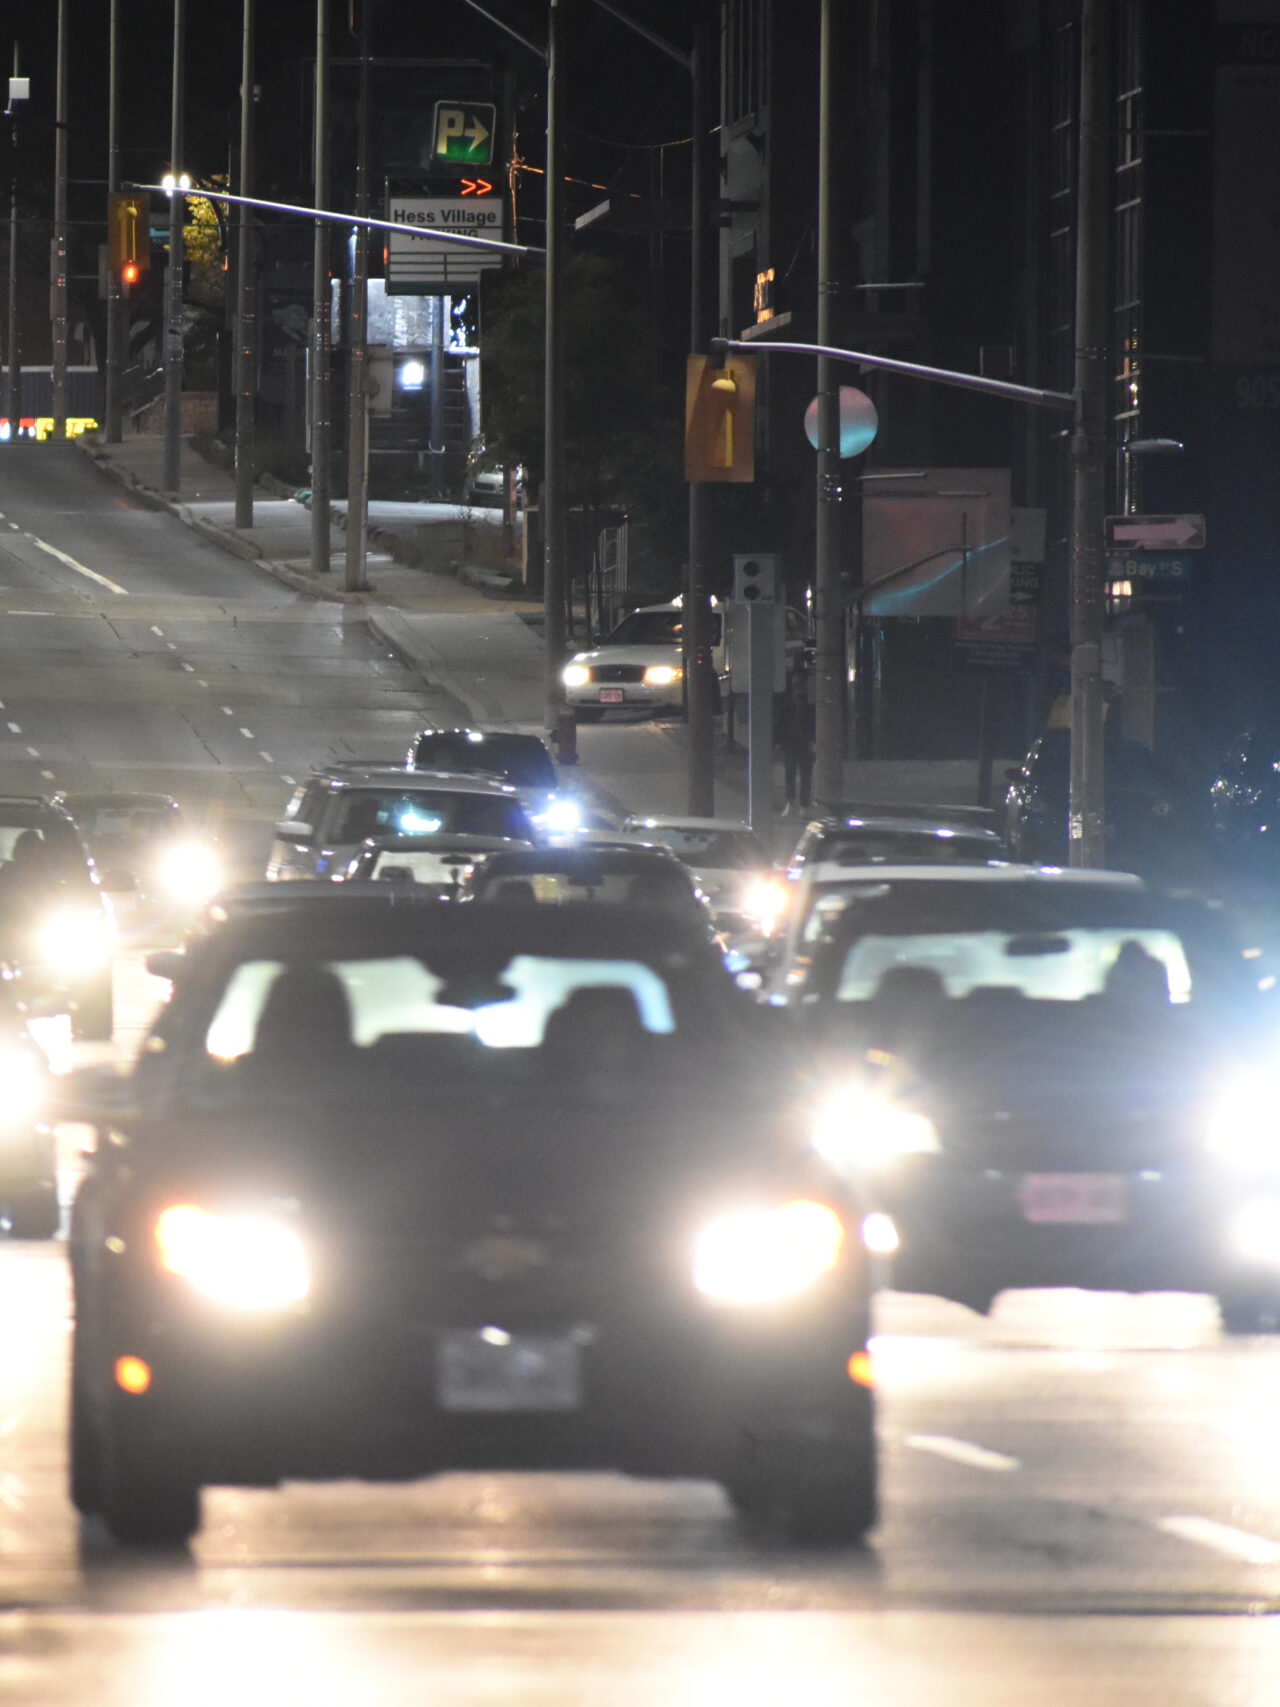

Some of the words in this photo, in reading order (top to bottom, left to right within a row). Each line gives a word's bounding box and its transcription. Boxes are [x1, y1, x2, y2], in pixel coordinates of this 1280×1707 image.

[436, 109, 465, 154] P
[394, 209, 436, 223] Hess
[440, 209, 497, 226] Village
[1126, 560, 1157, 579] Bay
[1171, 560, 1183, 577] S
